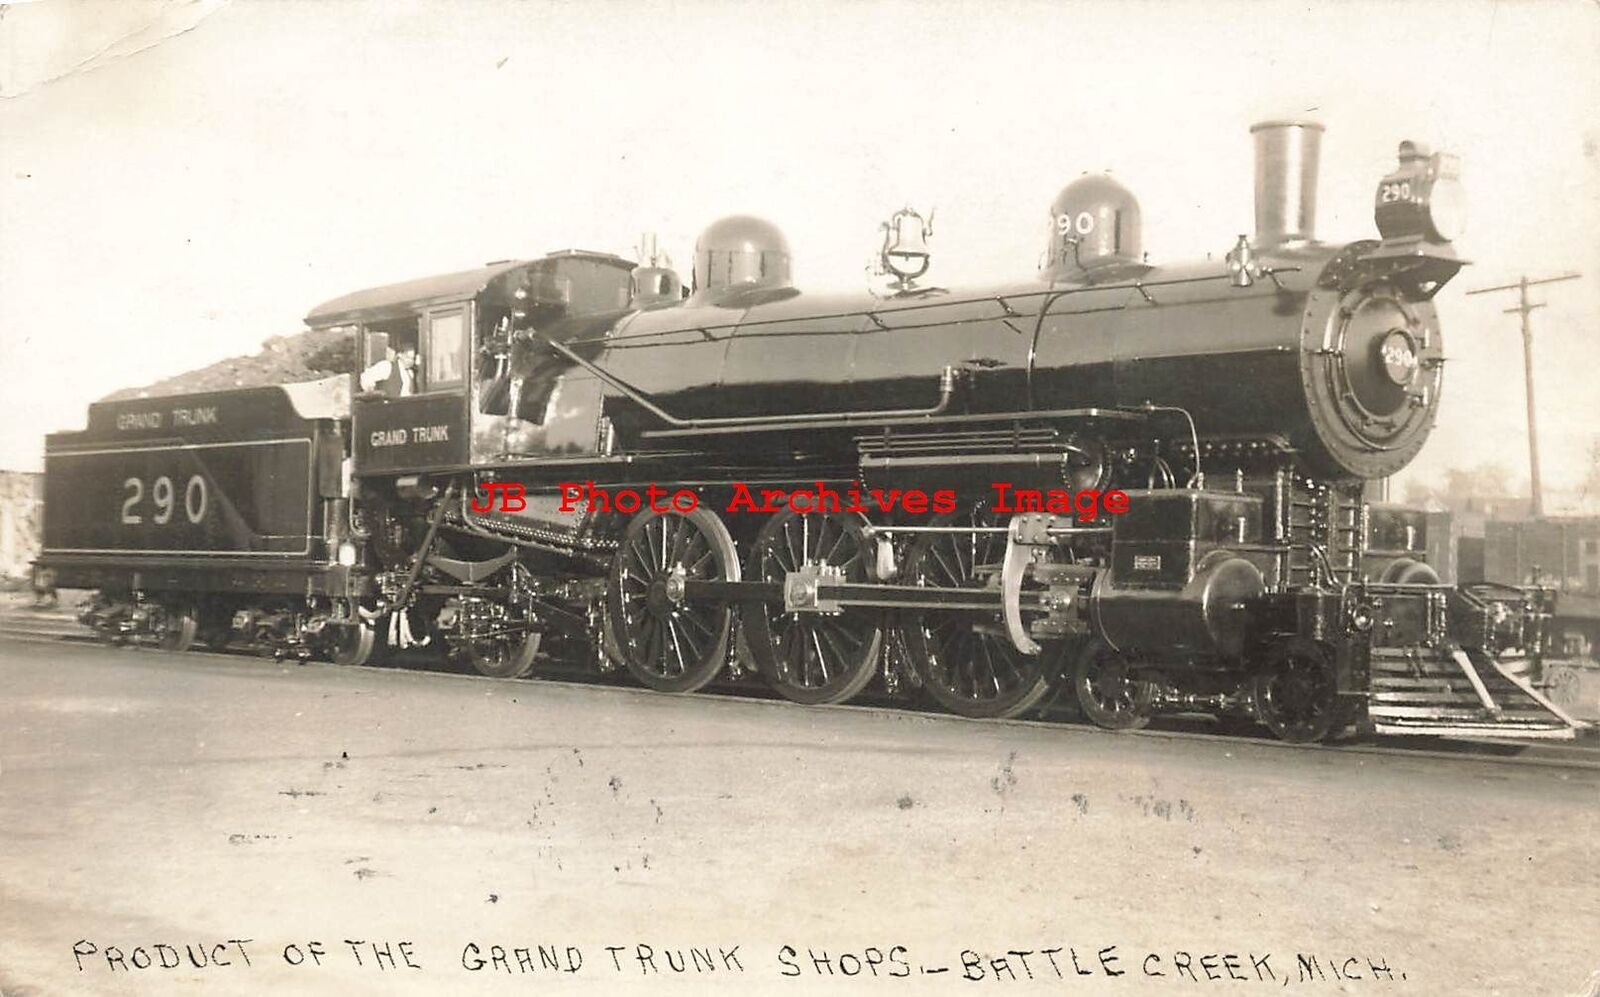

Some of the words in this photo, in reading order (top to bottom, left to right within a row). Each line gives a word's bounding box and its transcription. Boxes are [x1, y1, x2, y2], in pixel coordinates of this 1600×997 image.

[1382, 182, 1410, 203] 290
[117, 411, 161, 431] GRAND
[172, 406, 218, 426] TRUNK
[370, 428, 408, 447] GRAND
[412, 424, 449, 444] TRUNK
[121, 474, 208, 525] 290
[72, 939, 253, 972] PRODUCT
[283, 941, 326, 966] OF
[344, 940, 421, 970] THE
[462, 943, 582, 975] GRAND
[605, 944, 744, 975] TRUNK
[960, 945, 1126, 981] BATTLE
[1143, 951, 1289, 987] CREEK,
[1297, 953, 1407, 983] MICH.
